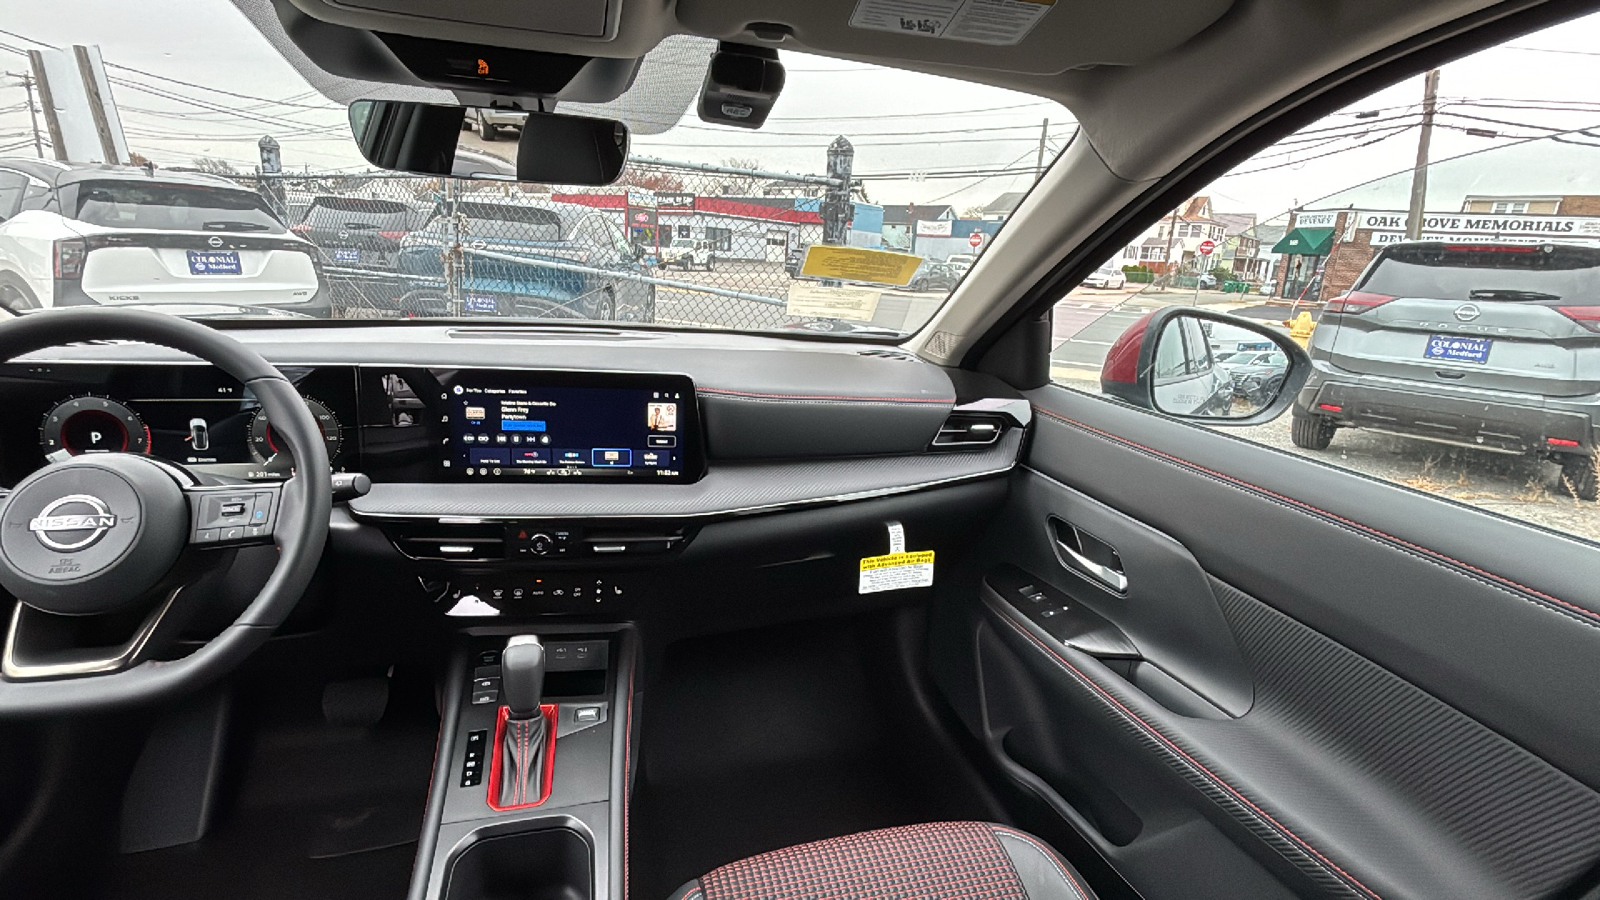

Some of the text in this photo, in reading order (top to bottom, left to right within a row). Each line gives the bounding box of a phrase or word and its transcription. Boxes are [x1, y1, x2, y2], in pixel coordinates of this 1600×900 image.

[1367, 216, 1401, 227] OAK
[1405, 218, 1460, 229] OVE
[1464, 219, 1574, 233] MEMORIALS
[1431, 340, 1487, 352] COLONIAL
[1446, 349, 1482, 359] Medford
[91, 432, 102, 444] P
[32, 517, 115, 529] NISSAN
